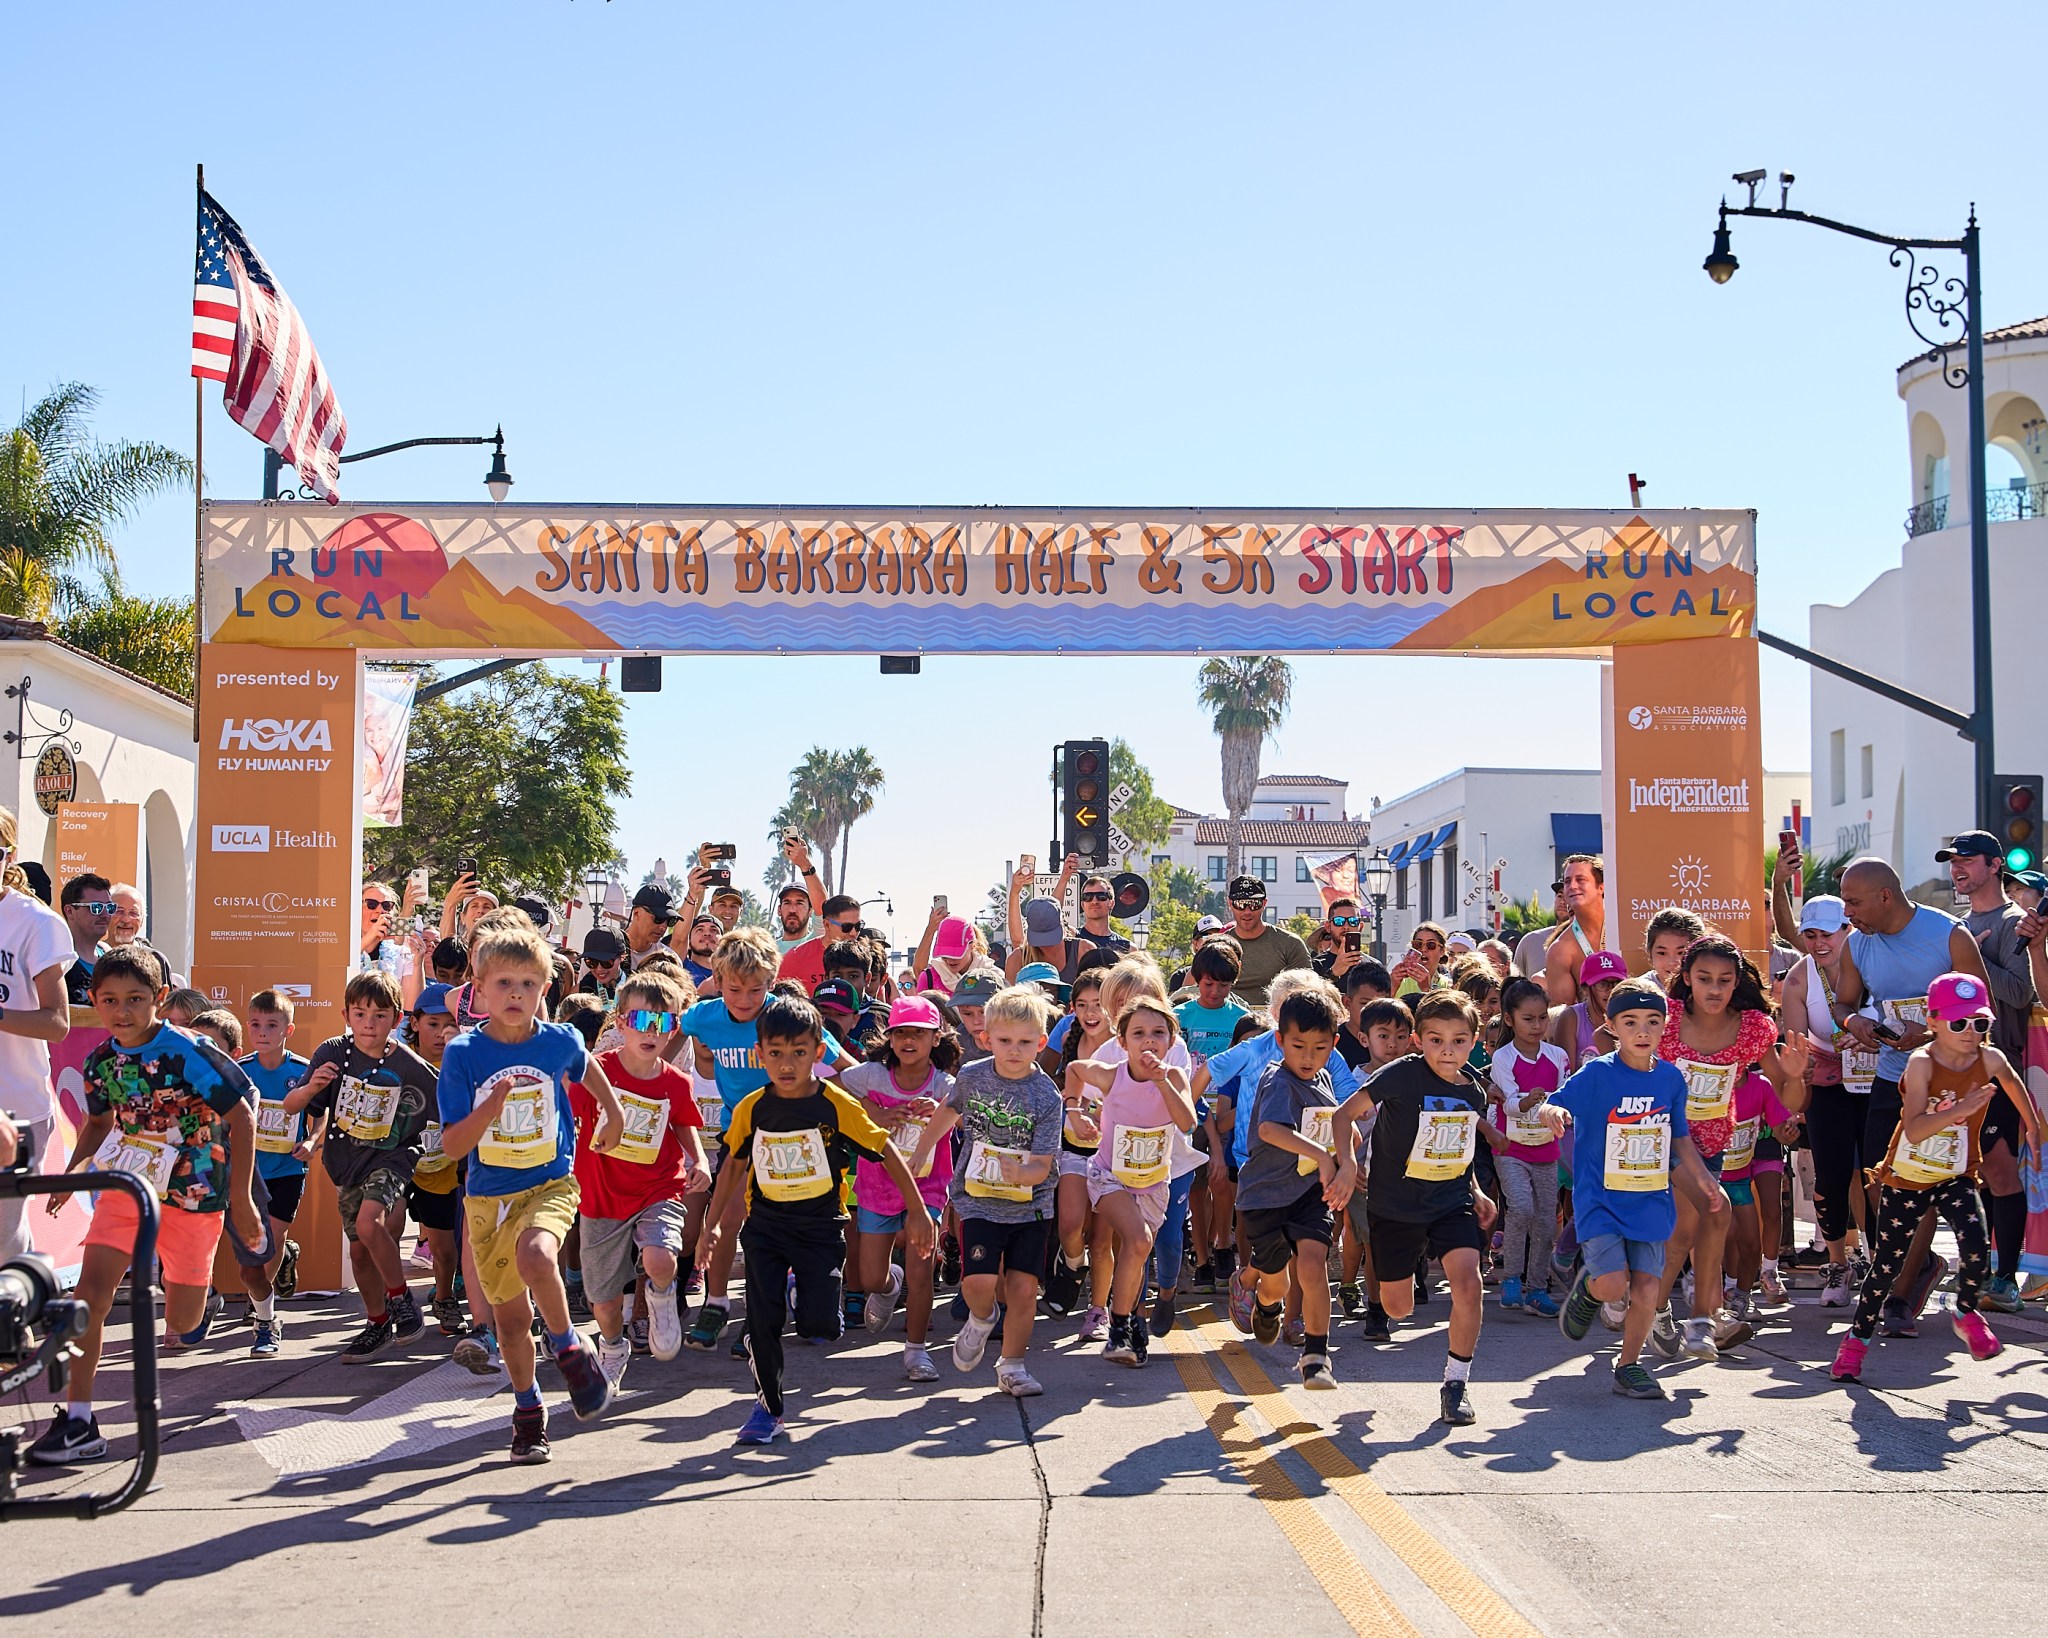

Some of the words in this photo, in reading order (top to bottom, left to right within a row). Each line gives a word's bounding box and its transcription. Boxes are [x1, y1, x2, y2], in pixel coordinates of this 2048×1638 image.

[271, 548, 383, 578] RUN
[536, 526, 709, 595] SANTA
[735, 527, 968, 596] BARBARA
[995, 528, 1121, 595] HALF
[1138, 527, 1182, 594] &
[1202, 526, 1275, 595] 5K
[1299, 527, 1464, 595] START
[1585, 550, 1693, 580] RUN
[235, 586, 420, 621] LOCAL
[1552, 588, 1730, 621] LOCAL
[216, 670, 310, 688] presented
[317, 670, 339, 690] by
[1653, 706, 1690, 715] SANTA
[1692, 706, 1747, 715] BARBARA
[1691, 716, 1747, 725] RUNNING
[218, 718, 333, 752] HOKA
[218, 758, 242, 770] FLY
[245, 758, 304, 771] HUMAN
[306, 759, 331, 772] FLY
[36, 776, 71, 791] RAOUL
[1660, 777, 1681, 785] Santa
[1681, 777, 1711, 785] Barbara
[1629, 778, 1749, 813] Independent
[62, 809, 108, 820] Recovery
[62, 821, 87, 830] Zone
[219, 832, 262, 845] UCLA
[274, 830, 338, 848] Health
[61, 852, 87, 861] Bike/
[60, 864, 97, 873] Stroller
[1035, 877, 1053, 885] LEFT
[213, 897, 260, 906] CRISTAL
[291, 897, 337, 907] CLARKE
[1631, 898, 1677, 910] SANTA
[1682, 899, 1751, 910] BARBARA
[1600, 956, 1614, 968] LA
[490, 1067, 528, 1084] APOLLO
[343, 1087, 395, 1117] 2023
[1617, 1096, 1655, 1114] JUST
[490, 1098, 551, 1135] 023
[623, 1105, 665, 1137] 023
[1418, 1123, 1473, 1151] 2023
[756, 1141, 822, 1171] 2023
[1117, 1134, 1169, 1162] 2023
[1611, 1135, 1667, 1162] 2023
[98, 1142, 167, 1183] 2023
[970, 1155, 1003, 1182] 20
